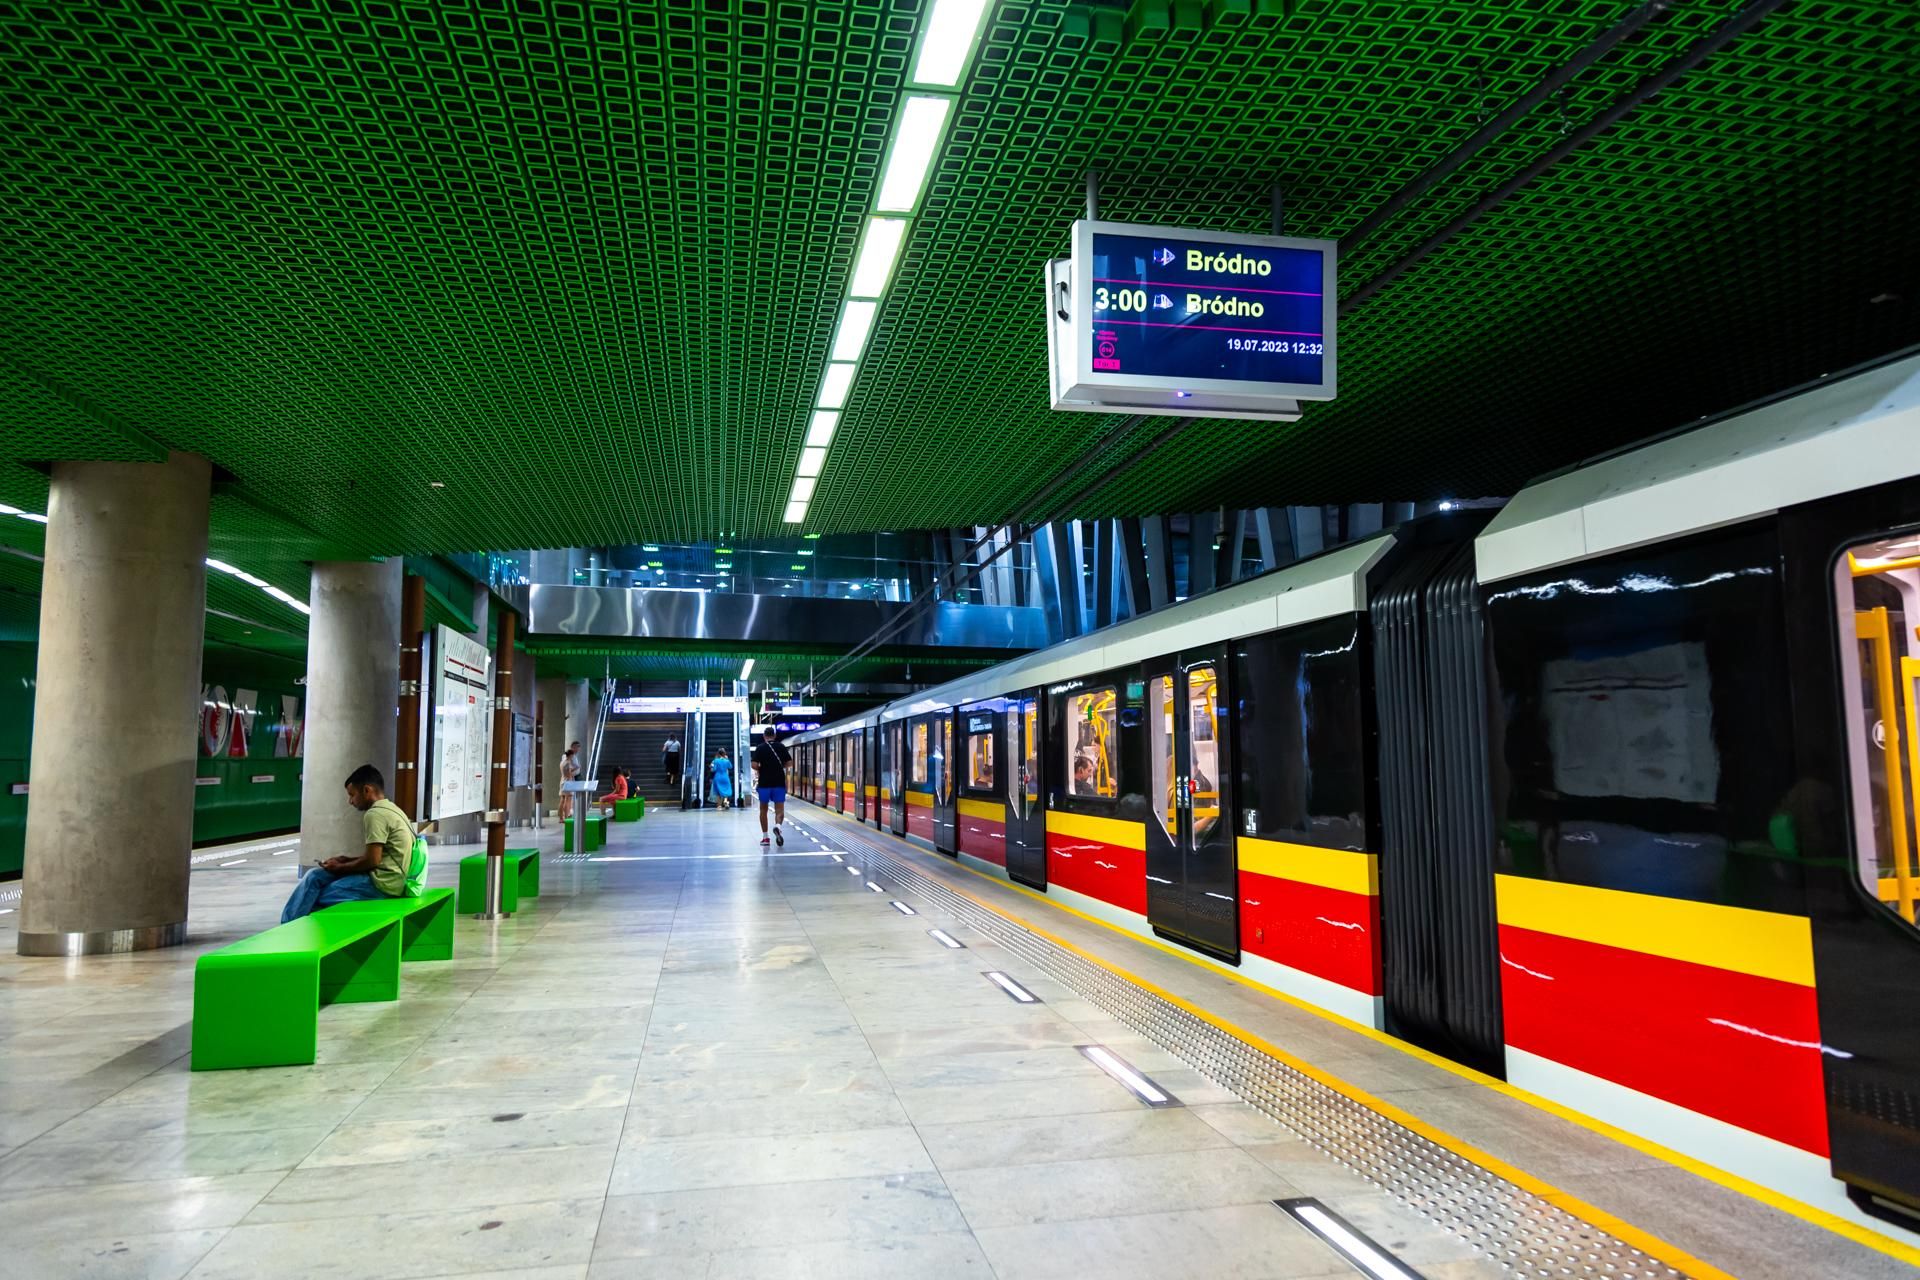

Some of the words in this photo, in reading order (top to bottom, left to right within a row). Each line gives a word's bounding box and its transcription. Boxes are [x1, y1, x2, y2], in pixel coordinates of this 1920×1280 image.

[1186, 250, 1271, 276] Bródno
[1095, 288, 1147, 312] 3:00
[1186, 293, 1264, 317] Bródno
[1227, 338, 1289, 352] 19.07.2023
[1292, 343, 1323, 355] 12:32
